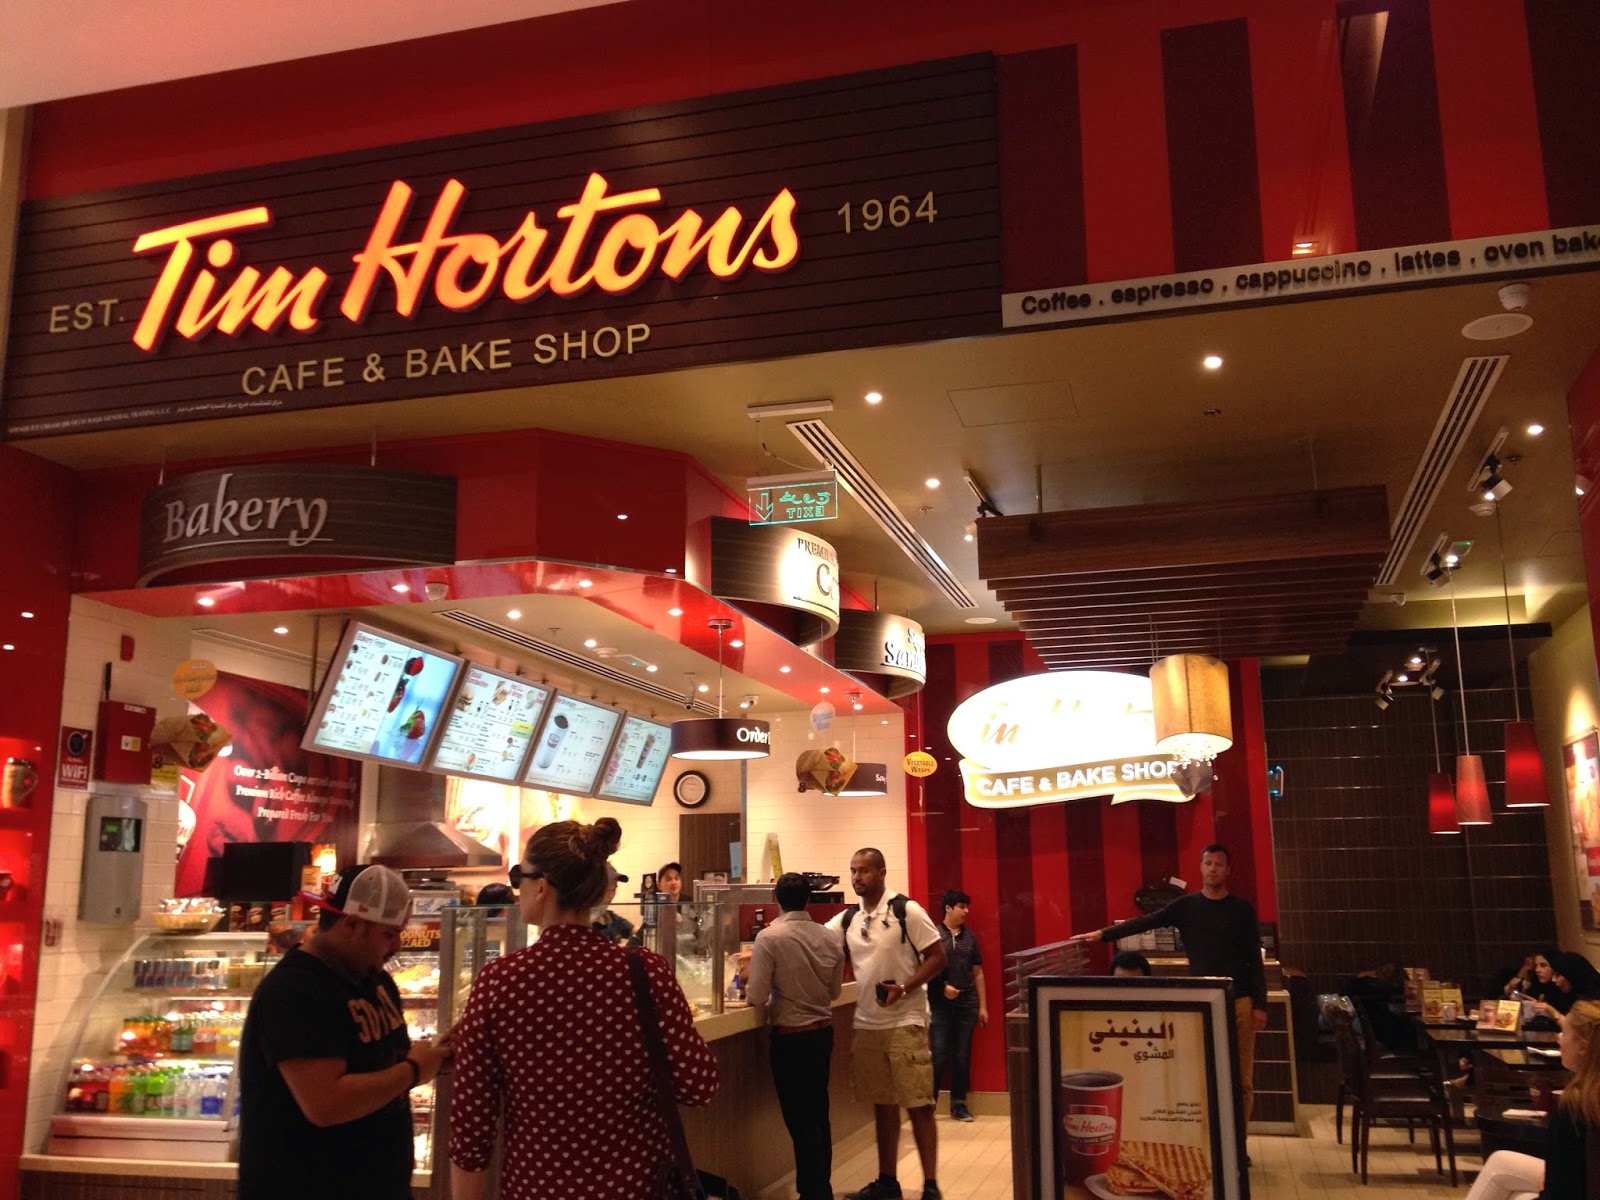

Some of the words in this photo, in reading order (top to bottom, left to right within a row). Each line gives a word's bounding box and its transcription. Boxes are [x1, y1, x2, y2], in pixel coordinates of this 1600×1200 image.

[837, 191, 938, 234] 1964
[133, 206, 328, 353] Tim
[340, 172, 799, 323] Hortons
[1020, 292, 1092, 316] Coffee
[1111, 275, 1214, 304] espresso
[1235, 257, 1372, 292] cappuccino
[1394, 246, 1461, 274] lattes
[1484, 240, 1545, 263] oven
[1552, 231, 1600, 255] bak
[49, 299, 125, 334] EST.
[241, 357, 345, 396] CAFE
[362, 353, 386, 382] &
[406, 338, 512, 379] BAKE
[532, 323, 652, 364] SHOP
[163, 473, 328, 547] Bakery
[975, 775, 1035, 797] CAFE
[1038, 776, 1053, 791] &
[1056, 765, 1118, 788] BAKE
[1089, 1018, 1175, 1052] البنيني
[1133, 1046, 1175, 1063] المشوي
